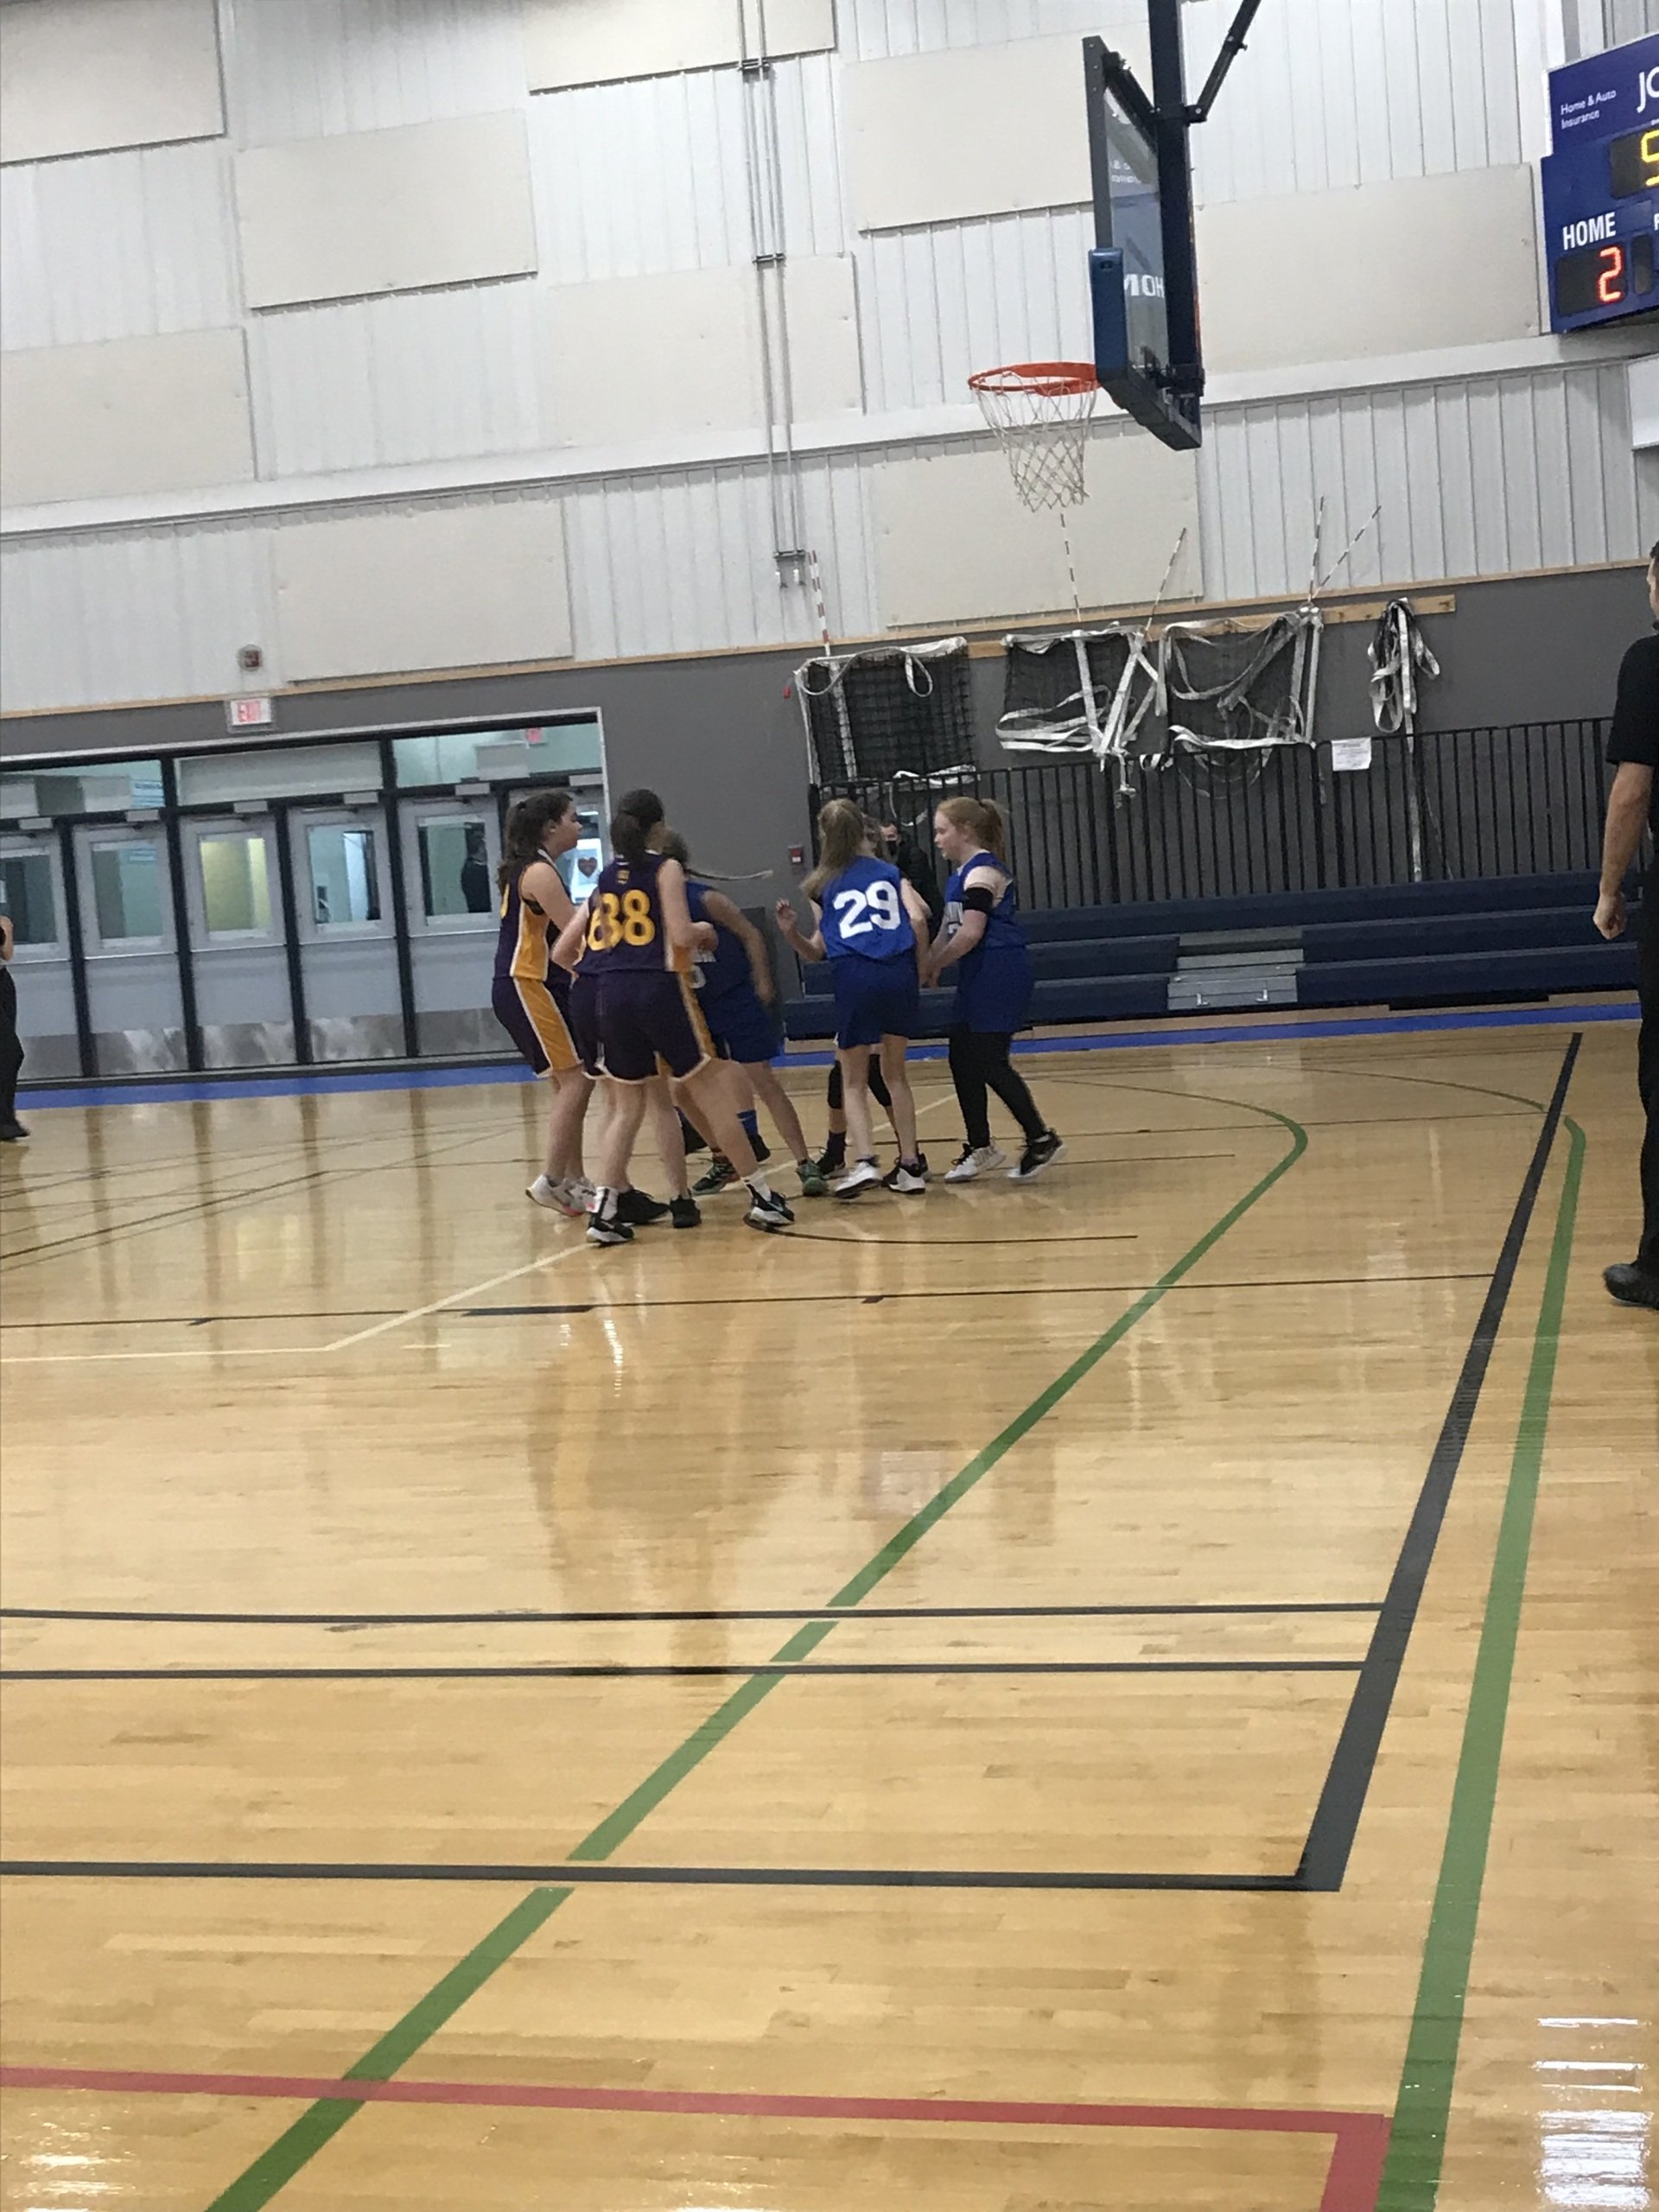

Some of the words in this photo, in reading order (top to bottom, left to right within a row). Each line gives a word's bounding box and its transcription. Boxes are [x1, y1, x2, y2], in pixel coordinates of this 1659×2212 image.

[1560, 101, 1586, 115] Home
[1588, 95, 1594, 106] &
[1596, 90, 1617, 104] Auto
[1561, 110, 1599, 130] Insurance
[1562, 212, 1616, 251] HOME
[1599, 246, 1622, 302] 2
[833, 880, 901, 939] 29
